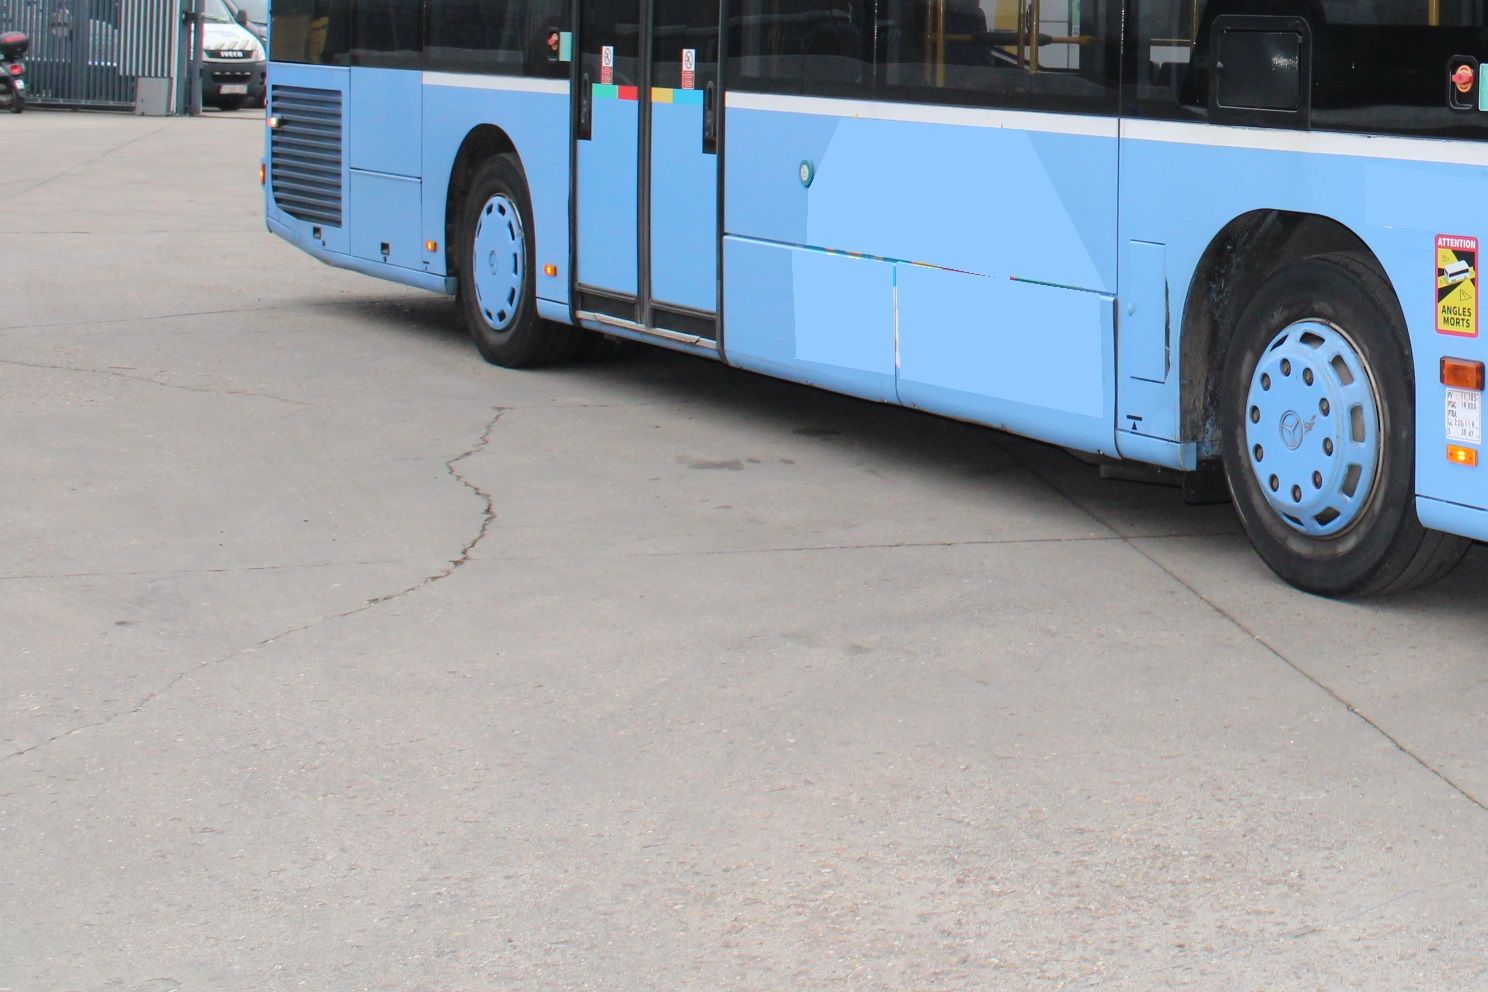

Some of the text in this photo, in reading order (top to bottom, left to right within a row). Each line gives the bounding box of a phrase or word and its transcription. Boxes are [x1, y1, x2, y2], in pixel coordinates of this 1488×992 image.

[1438, 238, 1476, 249] ATTENTION
[1441, 305, 1472, 317] ANGLES
[1443, 316, 1471, 328] MORTS
